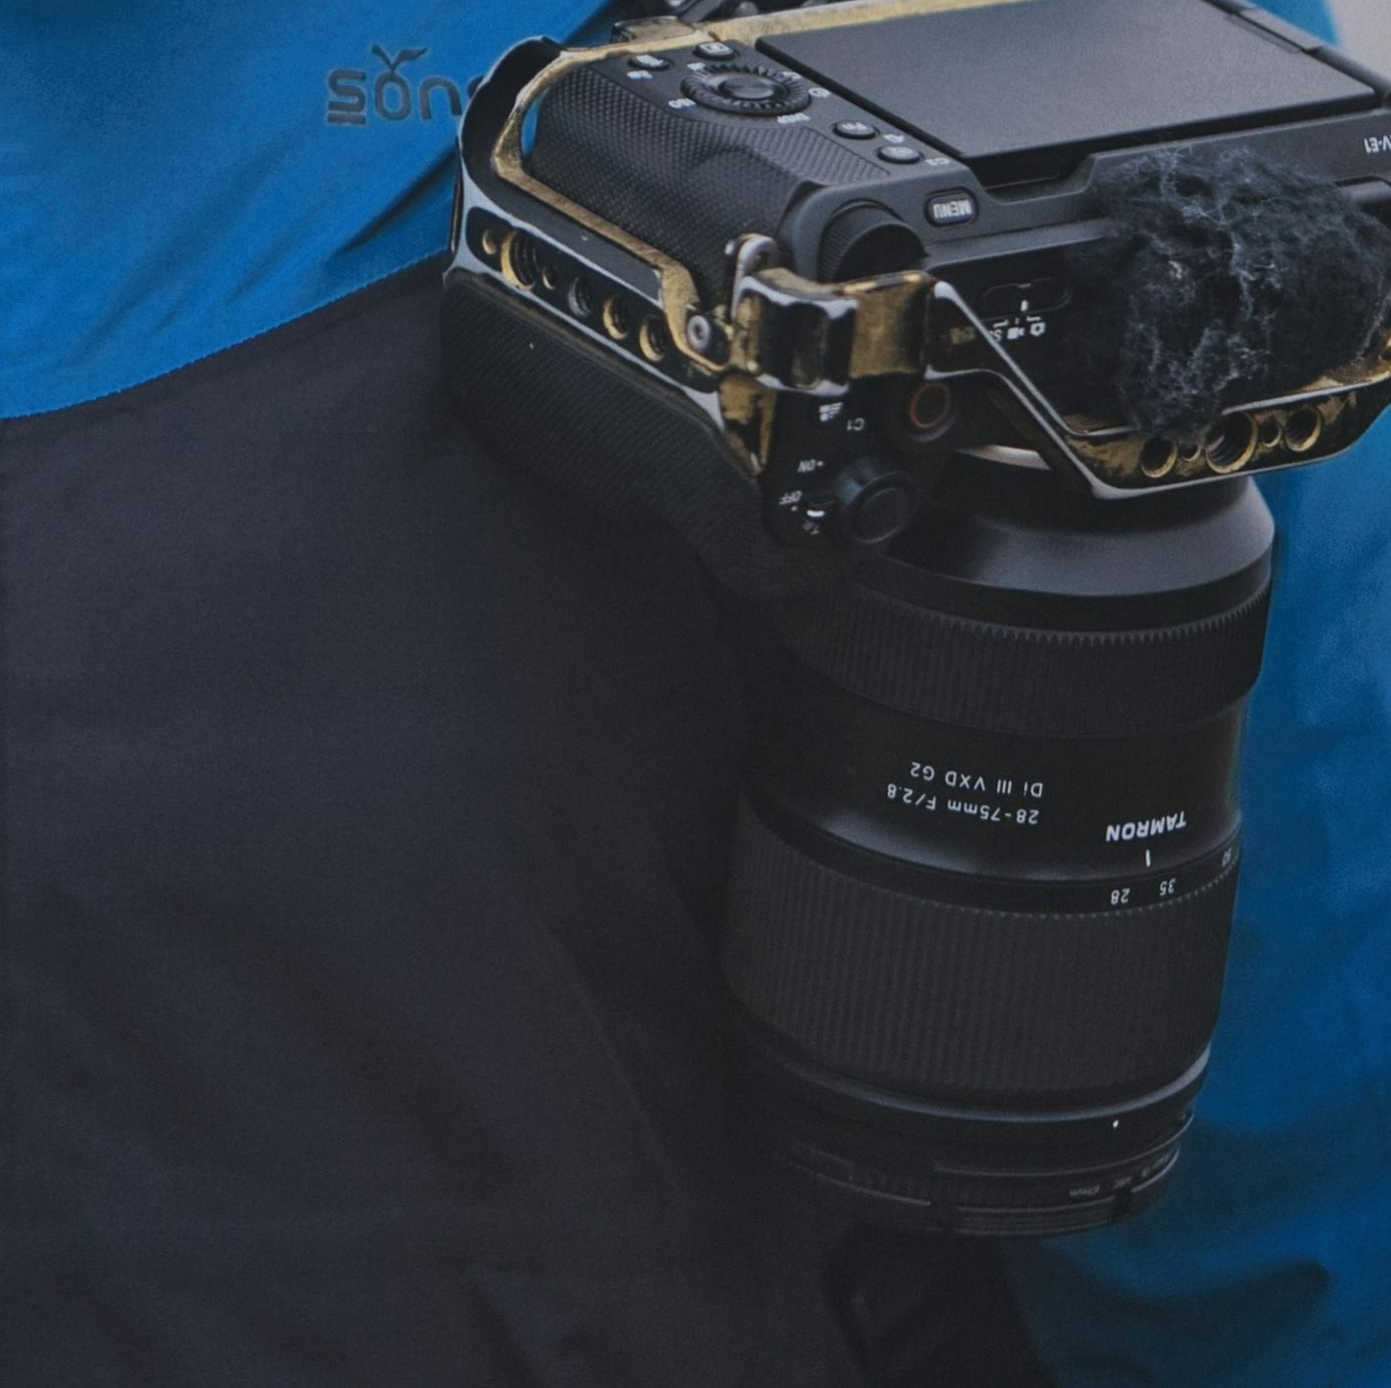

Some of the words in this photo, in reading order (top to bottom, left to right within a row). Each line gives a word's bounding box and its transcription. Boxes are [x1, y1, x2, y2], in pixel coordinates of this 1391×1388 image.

[327, 44, 483, 126] son
[1364, 134, 1391, 154] V-E1
[933, 199, 972, 219] MENU
[847, 418, 864, 431] C1
[798, 459, 816, 472] ON
[779, 490, 802, 505] OFF
[910, 761, 935, 780] G2
[945, 770, 986, 791] VXD
[886, 783, 937, 810] F/2.8
[997, 779, 1013, 794] III
[1023, 781, 1044, 797] Di
[947, 799, 1040, 825] 28-75mm
[1106, 811, 1186, 841] TAMRON
[1111, 888, 1131, 905] 28
[1160, 878, 1177, 896] 35
